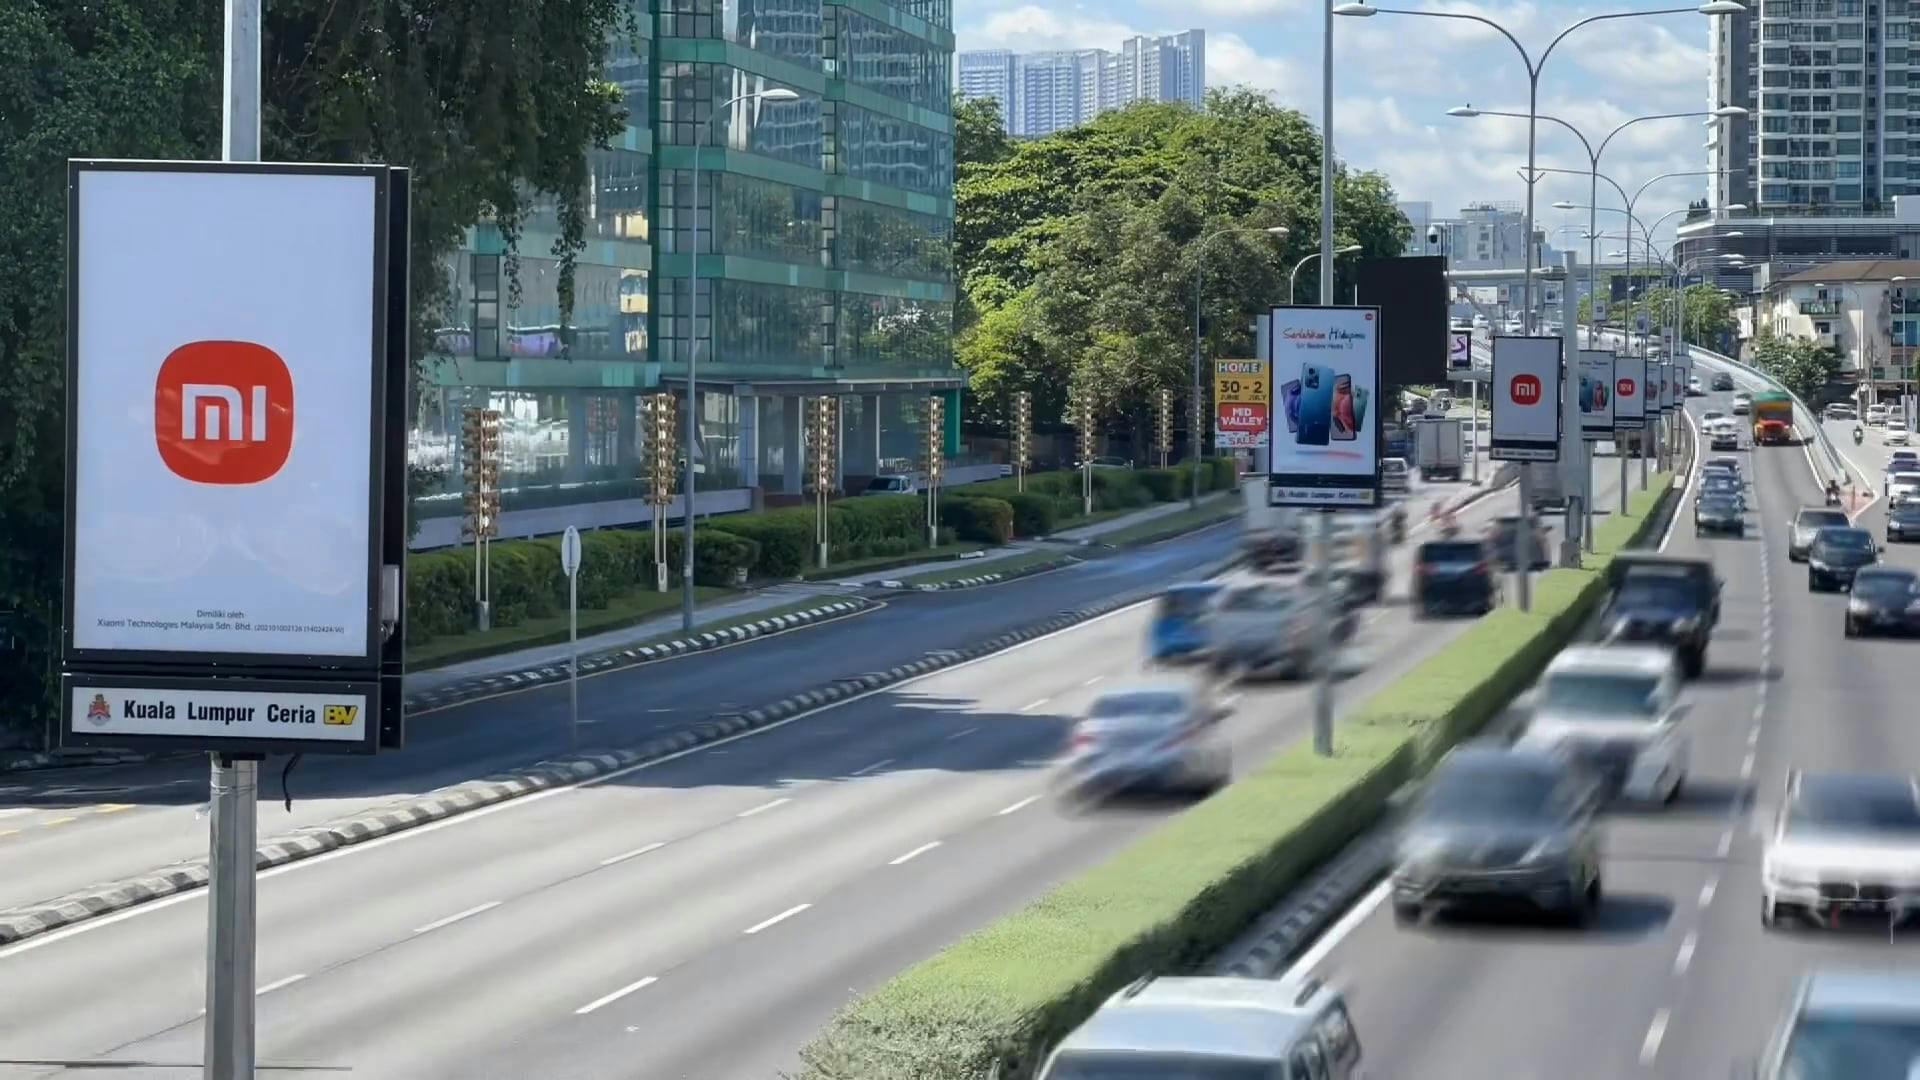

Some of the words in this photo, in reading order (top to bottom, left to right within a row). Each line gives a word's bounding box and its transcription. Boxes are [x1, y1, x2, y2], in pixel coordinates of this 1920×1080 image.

[1220, 380, 1240, 393] 30
[1253, 380, 1262, 394] 2
[1232, 407, 1252, 416] MID
[1221, 416, 1264, 426] VALLEY
[226, 610, 245, 619] oleh
[96, 618, 125, 628] Xiaomi
[127, 619, 179, 630] Technologies
[180, 621, 214, 631] Malaysia
[123, 699, 175, 720] Kuala
[187, 701, 255, 725] Lumpur
[267, 703, 316, 724] Ceria
